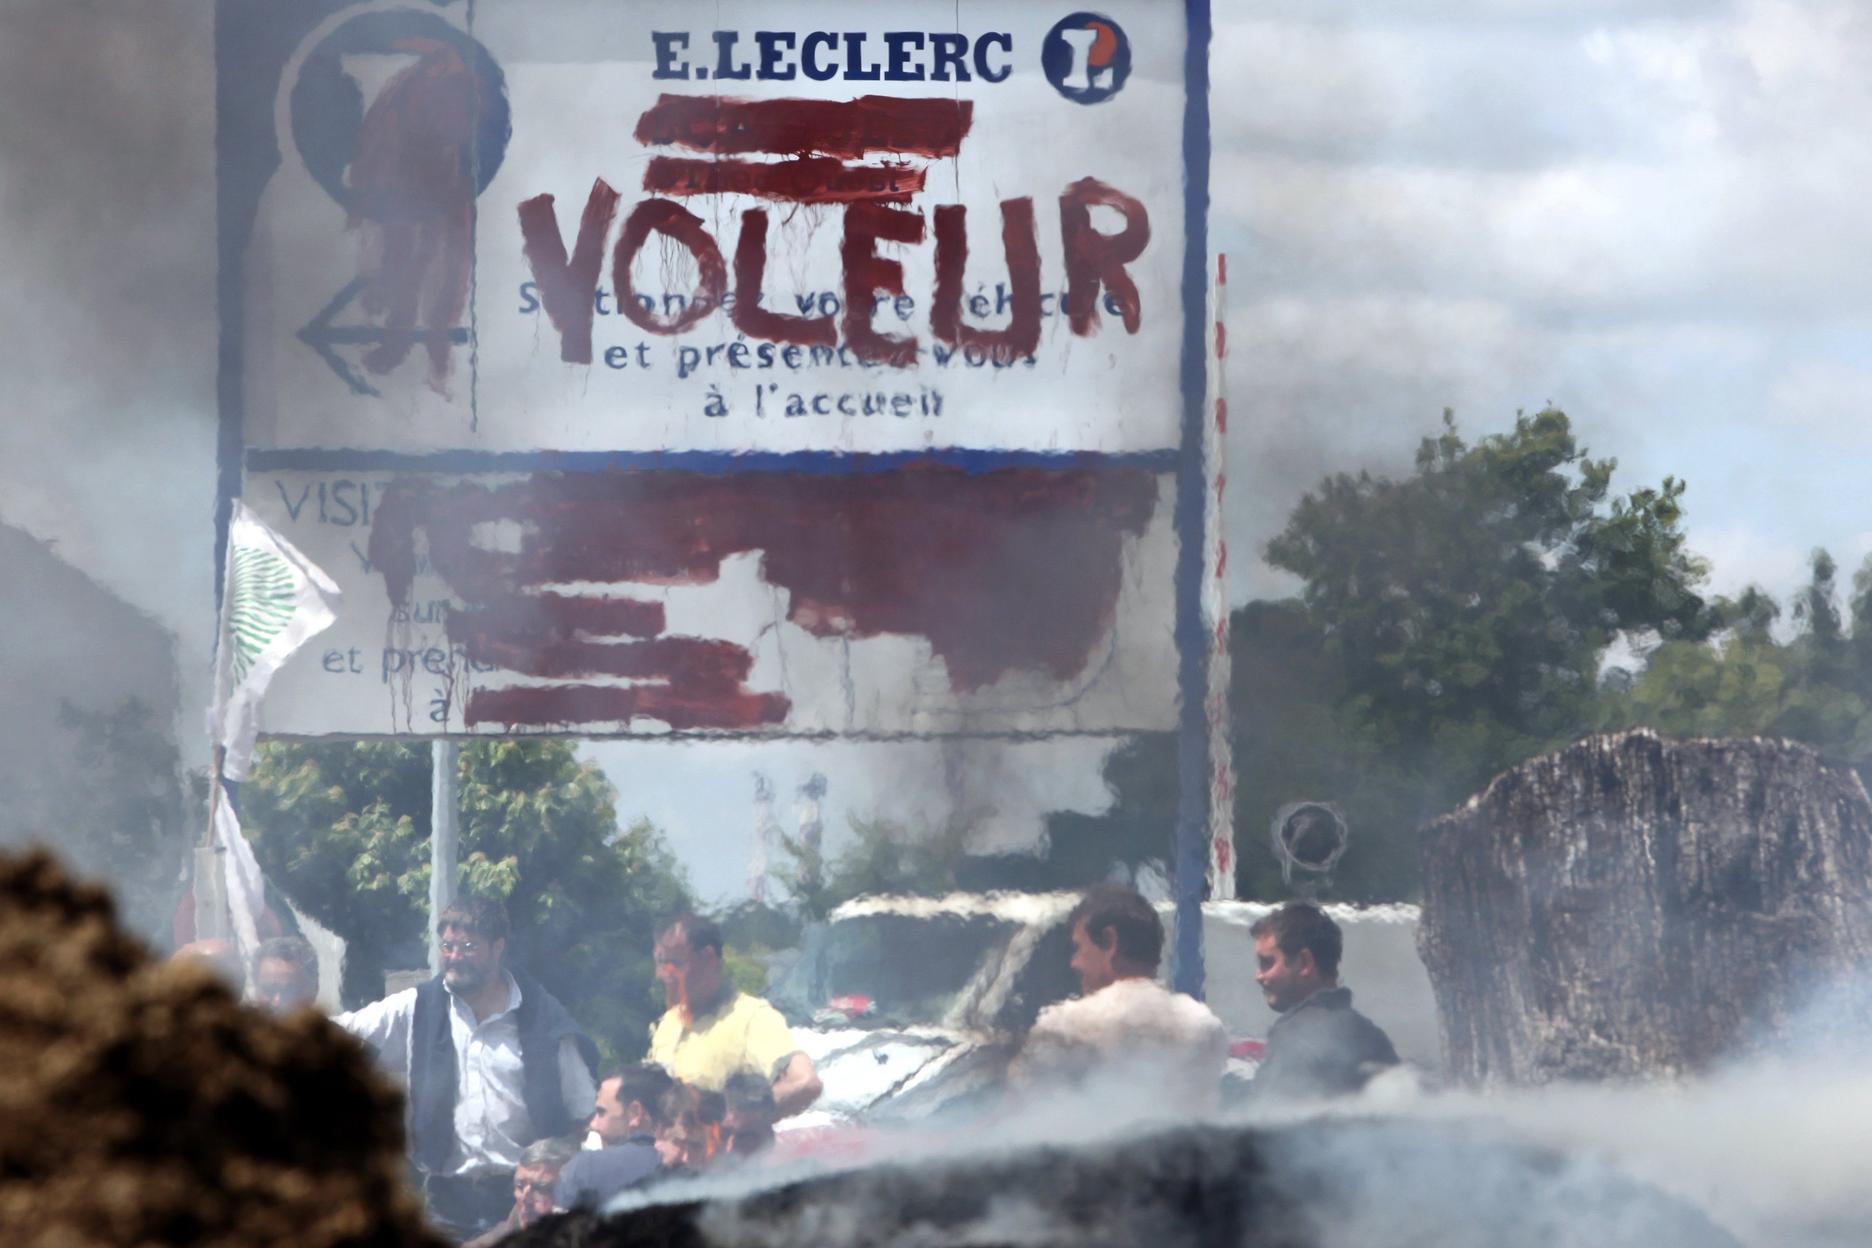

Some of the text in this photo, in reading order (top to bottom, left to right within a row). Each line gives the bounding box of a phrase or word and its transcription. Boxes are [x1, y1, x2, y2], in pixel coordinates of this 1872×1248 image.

[651, 31, 1013, 83] E.LECLERC
[517, 177, 1150, 368] VOLEUR
[794, 290, 916, 321] vore
[603, 342, 651, 371] et
[703, 382, 944, 419] à l'accueil
[275, 479, 392, 527] VISI
[322, 646, 363, 675] et
[429, 687, 450, 722] à
